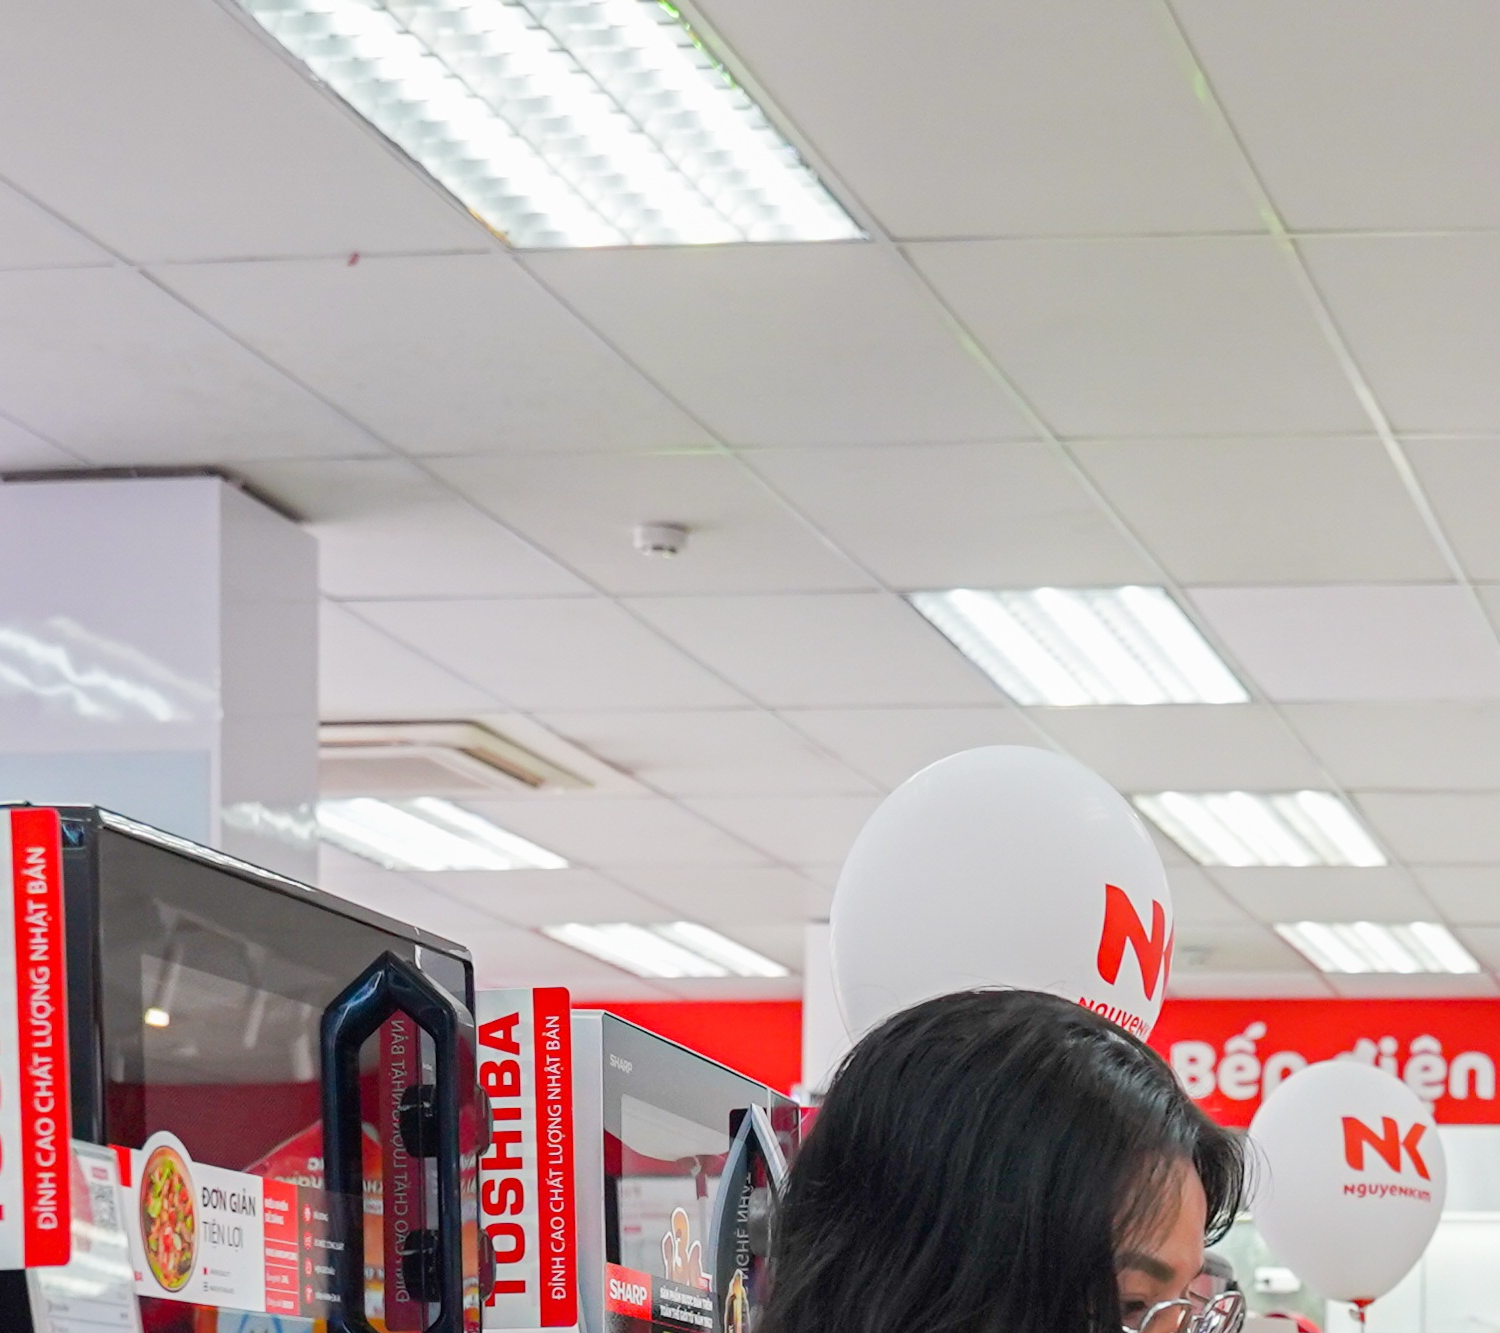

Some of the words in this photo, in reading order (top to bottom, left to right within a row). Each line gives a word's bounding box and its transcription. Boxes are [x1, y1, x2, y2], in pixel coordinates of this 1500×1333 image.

[23, 846, 47, 895] BẢN
[24, 899, 52, 961] NHẬT
[30, 965, 56, 1049] LƯỢNG
[545, 1015, 560, 1051] BẢN
[29, 1053, 55, 1113] CHẤT
[545, 1054, 563, 1100] NHẬT
[609, 1054, 633, 1074] SHARP
[35, 1116, 57, 1168] CAO
[547, 1104, 565, 1165] LƯỢNG
[1341, 1116, 1431, 1181] NK
[478, 1011, 527, 1308] TOSHIBA
[32, 1173, 58, 1230] ĐỈNH
[202, 1186, 227, 1212] ĐƠN
[230, 1188, 256, 1217] GIẢN
[548, 1170, 565, 1213] CHẤT
[202, 1218, 226, 1249] TIỆN
[551, 1216, 565, 1253] CAO
[550, 1257, 566, 1300] ĐỈNH
[609, 1278, 647, 1306] SHARP
